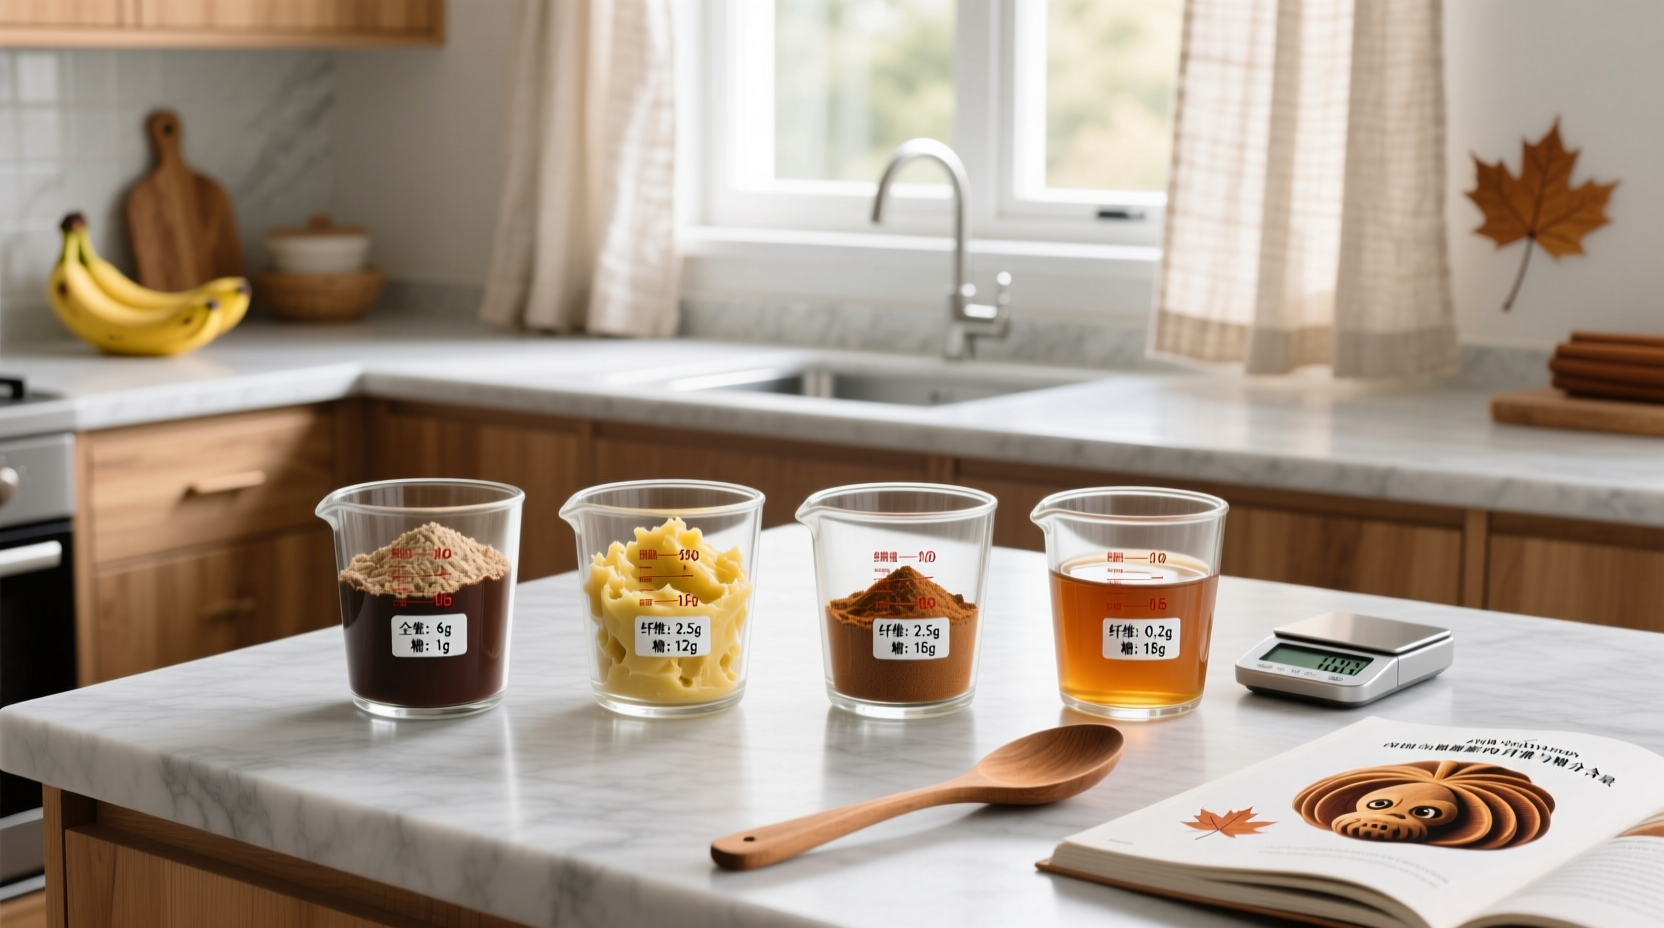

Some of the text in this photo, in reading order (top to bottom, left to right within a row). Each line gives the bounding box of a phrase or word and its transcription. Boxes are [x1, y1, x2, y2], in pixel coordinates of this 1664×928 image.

[436, 622, 452, 637] 6g
[675, 622, 702, 637] 2.5g
[914, 624, 940, 640] 2.5g
[436, 639, 450, 654] 1g
[675, 640, 698, 655] 12g
[914, 641, 936, 657] 16g
